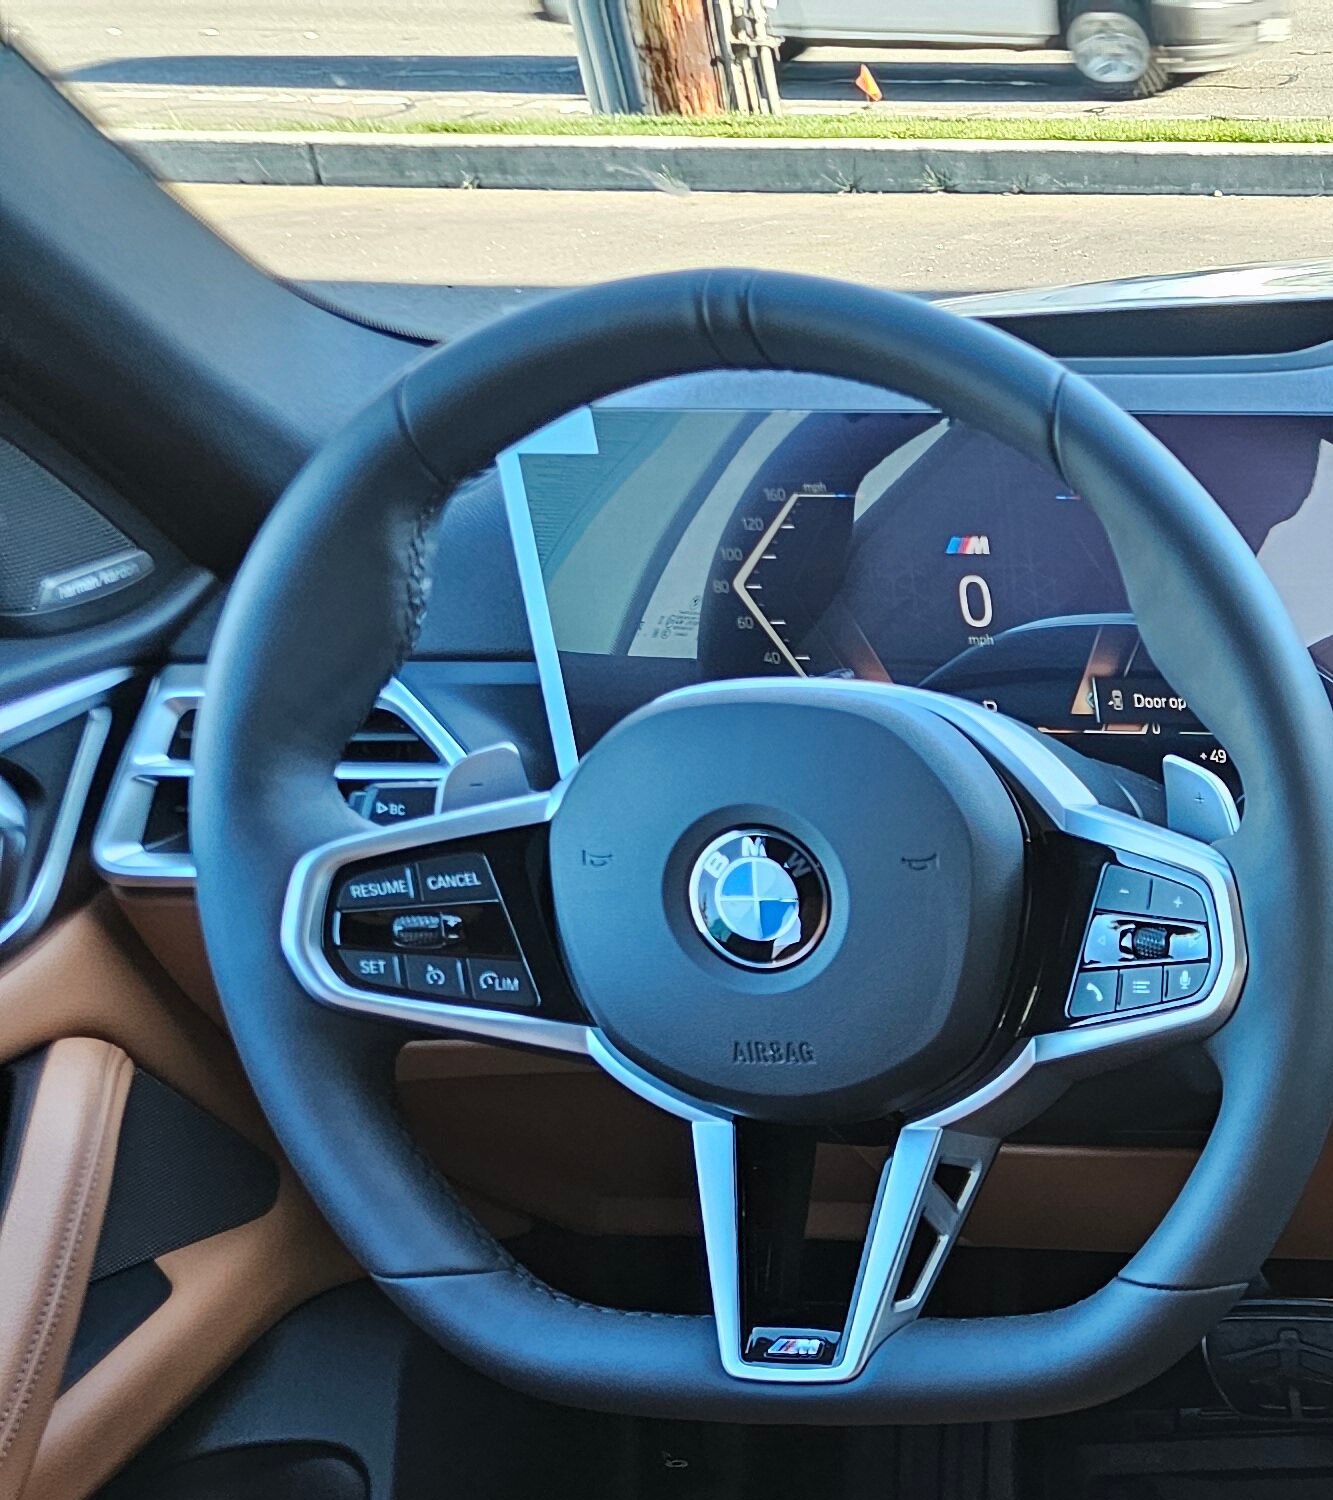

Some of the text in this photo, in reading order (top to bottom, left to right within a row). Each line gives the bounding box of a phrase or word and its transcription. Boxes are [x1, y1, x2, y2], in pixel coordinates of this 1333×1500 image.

[763, 488, 785, 500] 160
[742, 518, 764, 531] 120
[721, 549, 743, 561] 100
[713, 581, 729, 594] 80
[958, 574, 993, 628] 0
[737, 617, 754, 629] 60
[968, 634, 995, 648] mph
[764, 652, 781, 664] 40
[1134, 694, 1167, 708] Door
[704, 836, 814, 879] BMW
[427, 871, 482, 891] CANCEL
[350, 879, 409, 898] RESUME
[359, 960, 386, 975] SET
[494, 977, 519, 991] LIM
[732, 1039, 816, 1064] AIRBAG
